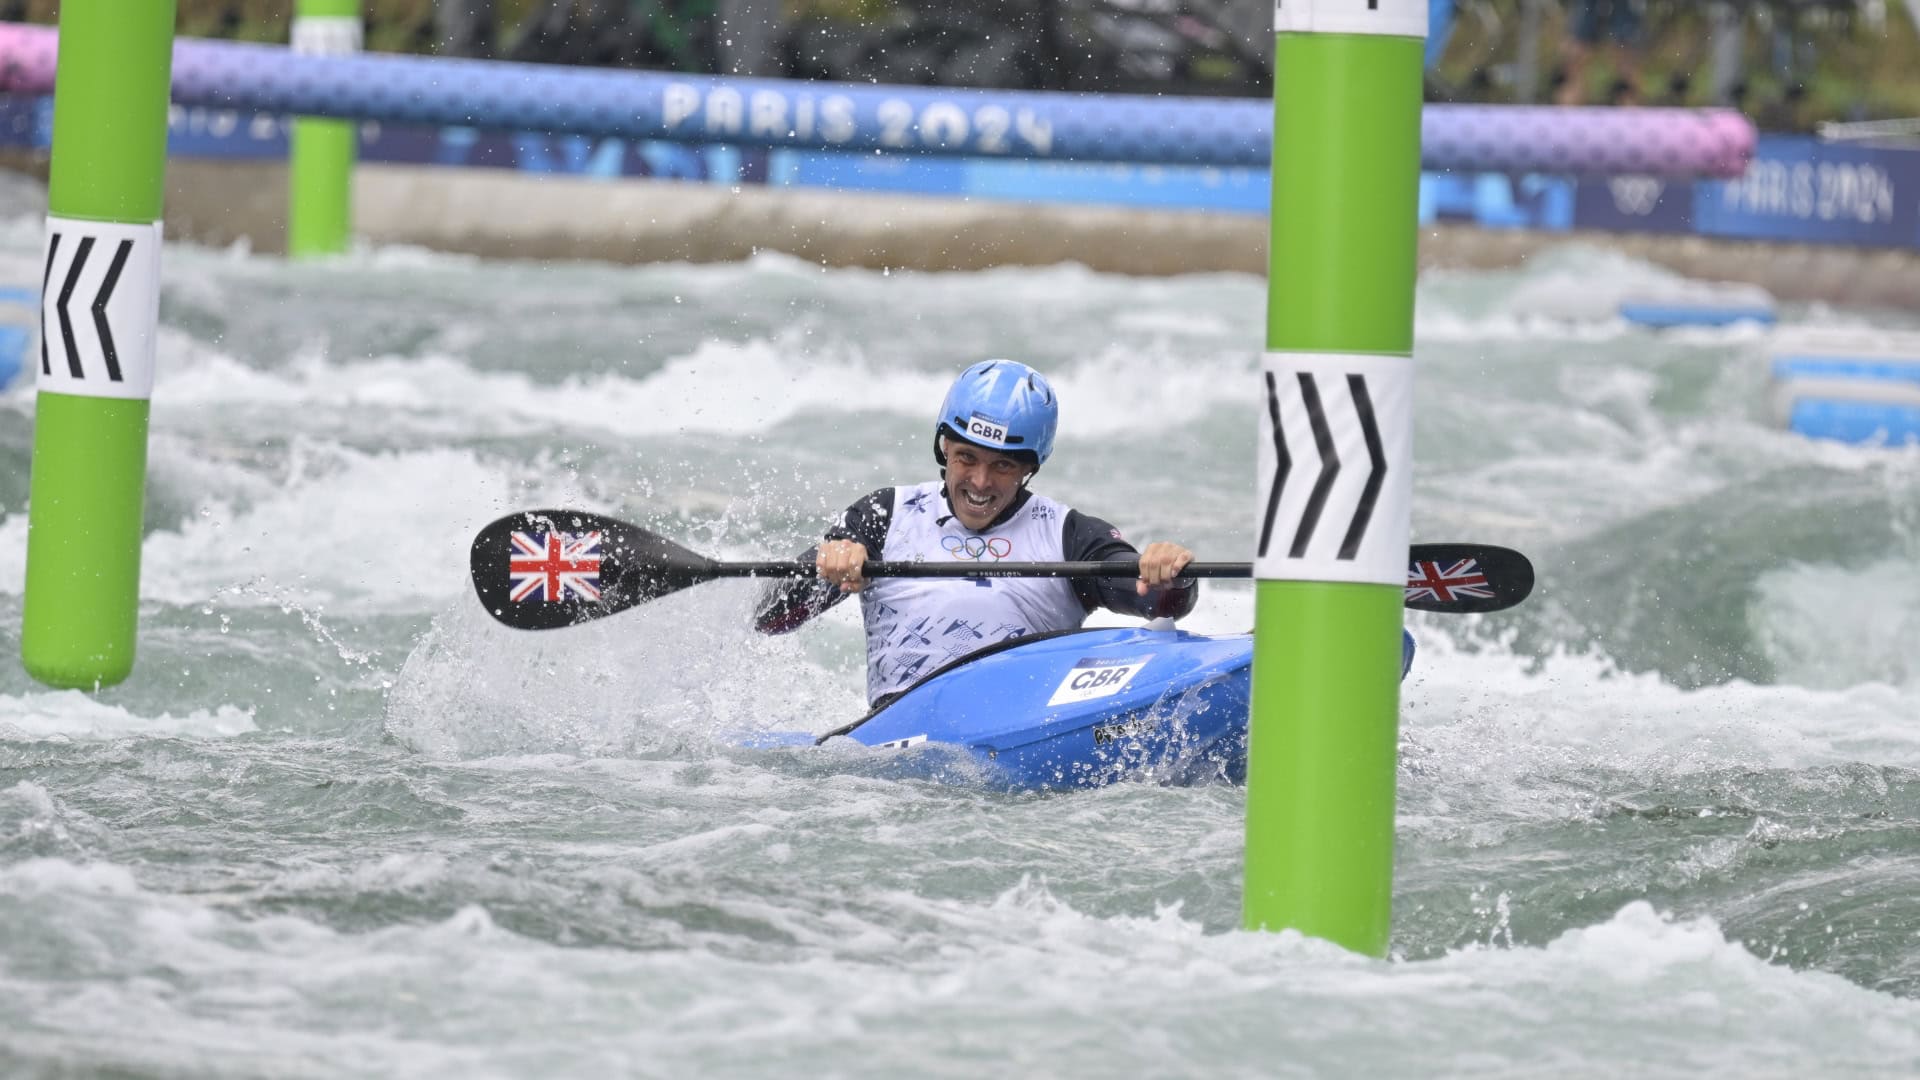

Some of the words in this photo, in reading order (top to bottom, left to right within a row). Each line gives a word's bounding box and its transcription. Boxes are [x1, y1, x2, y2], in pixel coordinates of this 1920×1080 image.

[662, 82, 857, 144] PARIS
[876, 98, 1053, 156] 2024
[971, 422, 1003, 441] GBR
[1070, 667, 1130, 691] GBR
